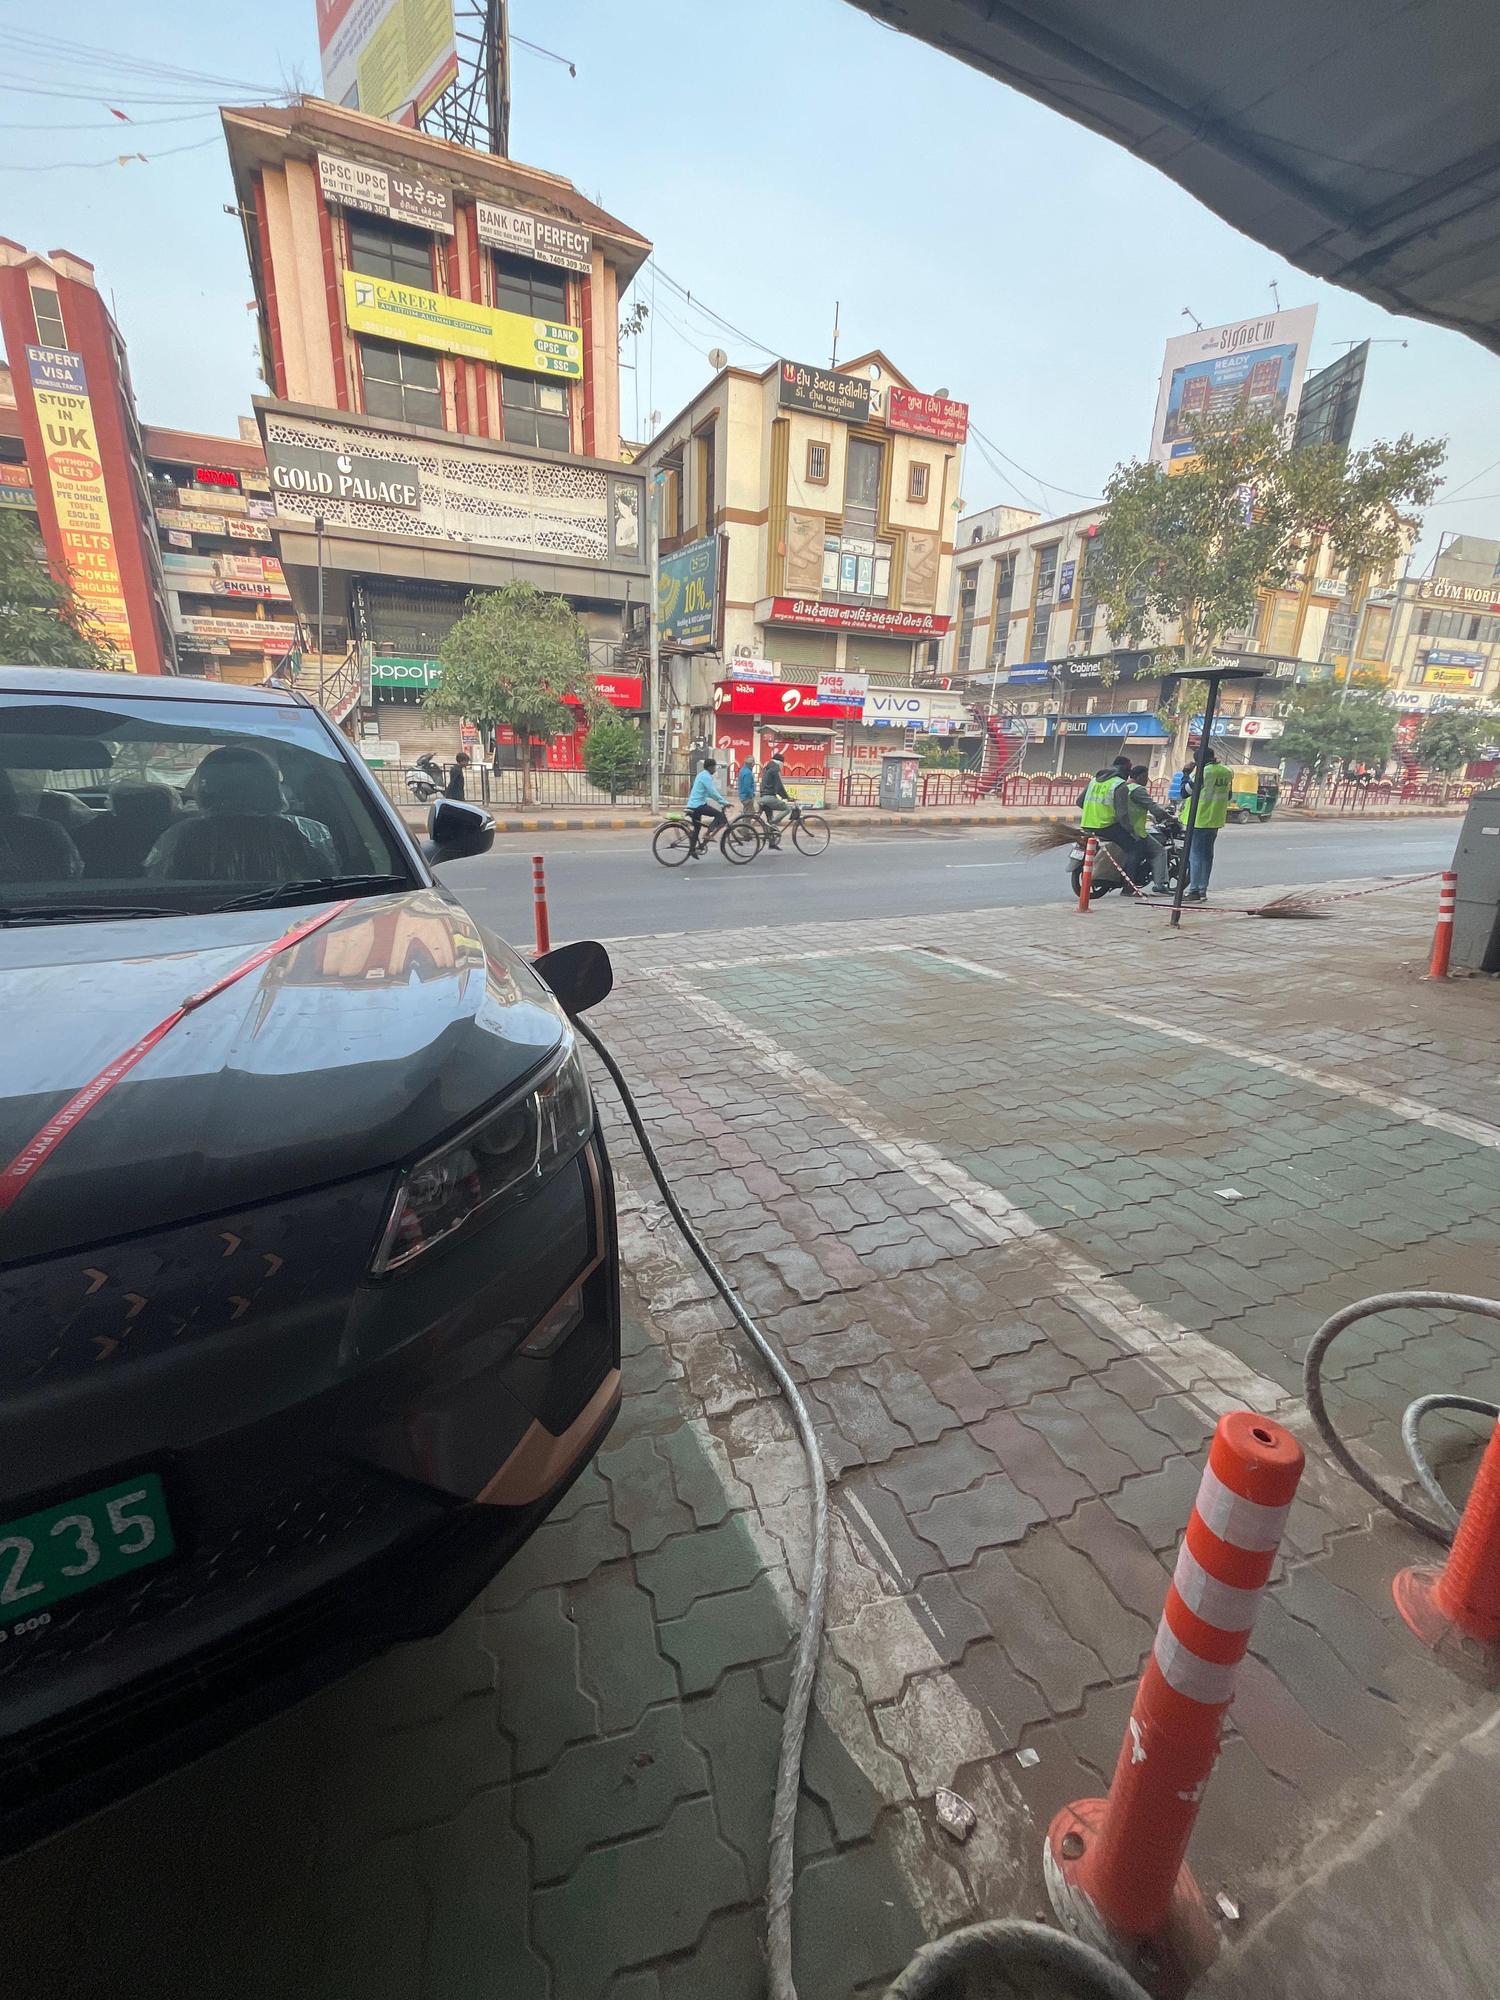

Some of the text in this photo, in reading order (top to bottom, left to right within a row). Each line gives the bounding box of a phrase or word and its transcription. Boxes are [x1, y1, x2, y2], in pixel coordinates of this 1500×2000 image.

[320, 161, 386, 190] GPSC UPSC
[322, 177, 353, 192] PSI TET
[479, 209, 532, 236] BANK CAT
[536, 222, 590, 254] PERFECT
[376, 285, 438, 312] CAREER
[453, 320, 491, 335] COMPANY
[551, 327, 574, 342] BANK
[1219, 321, 1264, 353] Signet
[537, 341, 560, 354] GPSC
[29, 350, 80, 368] EXPERT
[553, 360, 569, 371] SSC
[1215, 355, 1250, 369] READY
[41, 366, 74, 382] VISA
[796, 368, 810, 387] દીપ
[38, 393, 85, 410] STUDY
[58, 409, 73, 422] IN
[46, 424, 91, 450] UK
[53, 456, 95, 468] WITHOUT
[58, 465, 94, 479] IELTS
[273, 465, 333, 494] GOLD
[339, 475, 417, 506] PALACE
[56, 490, 103, 503] PTE ONLINE
[65, 532, 112, 550] IELTS
[76, 551, 107, 567] PTE
[74, 581, 120, 594] ENGLISH
[224, 581, 271, 593] ENGLISH
[684, 576, 706, 614] 10%
[1434, 583, 1462, 599] GYM
[872, 694, 921, 712] vivo
[1394, 691, 1419, 704] vivo
[1099, 719, 1138, 735] vivo
